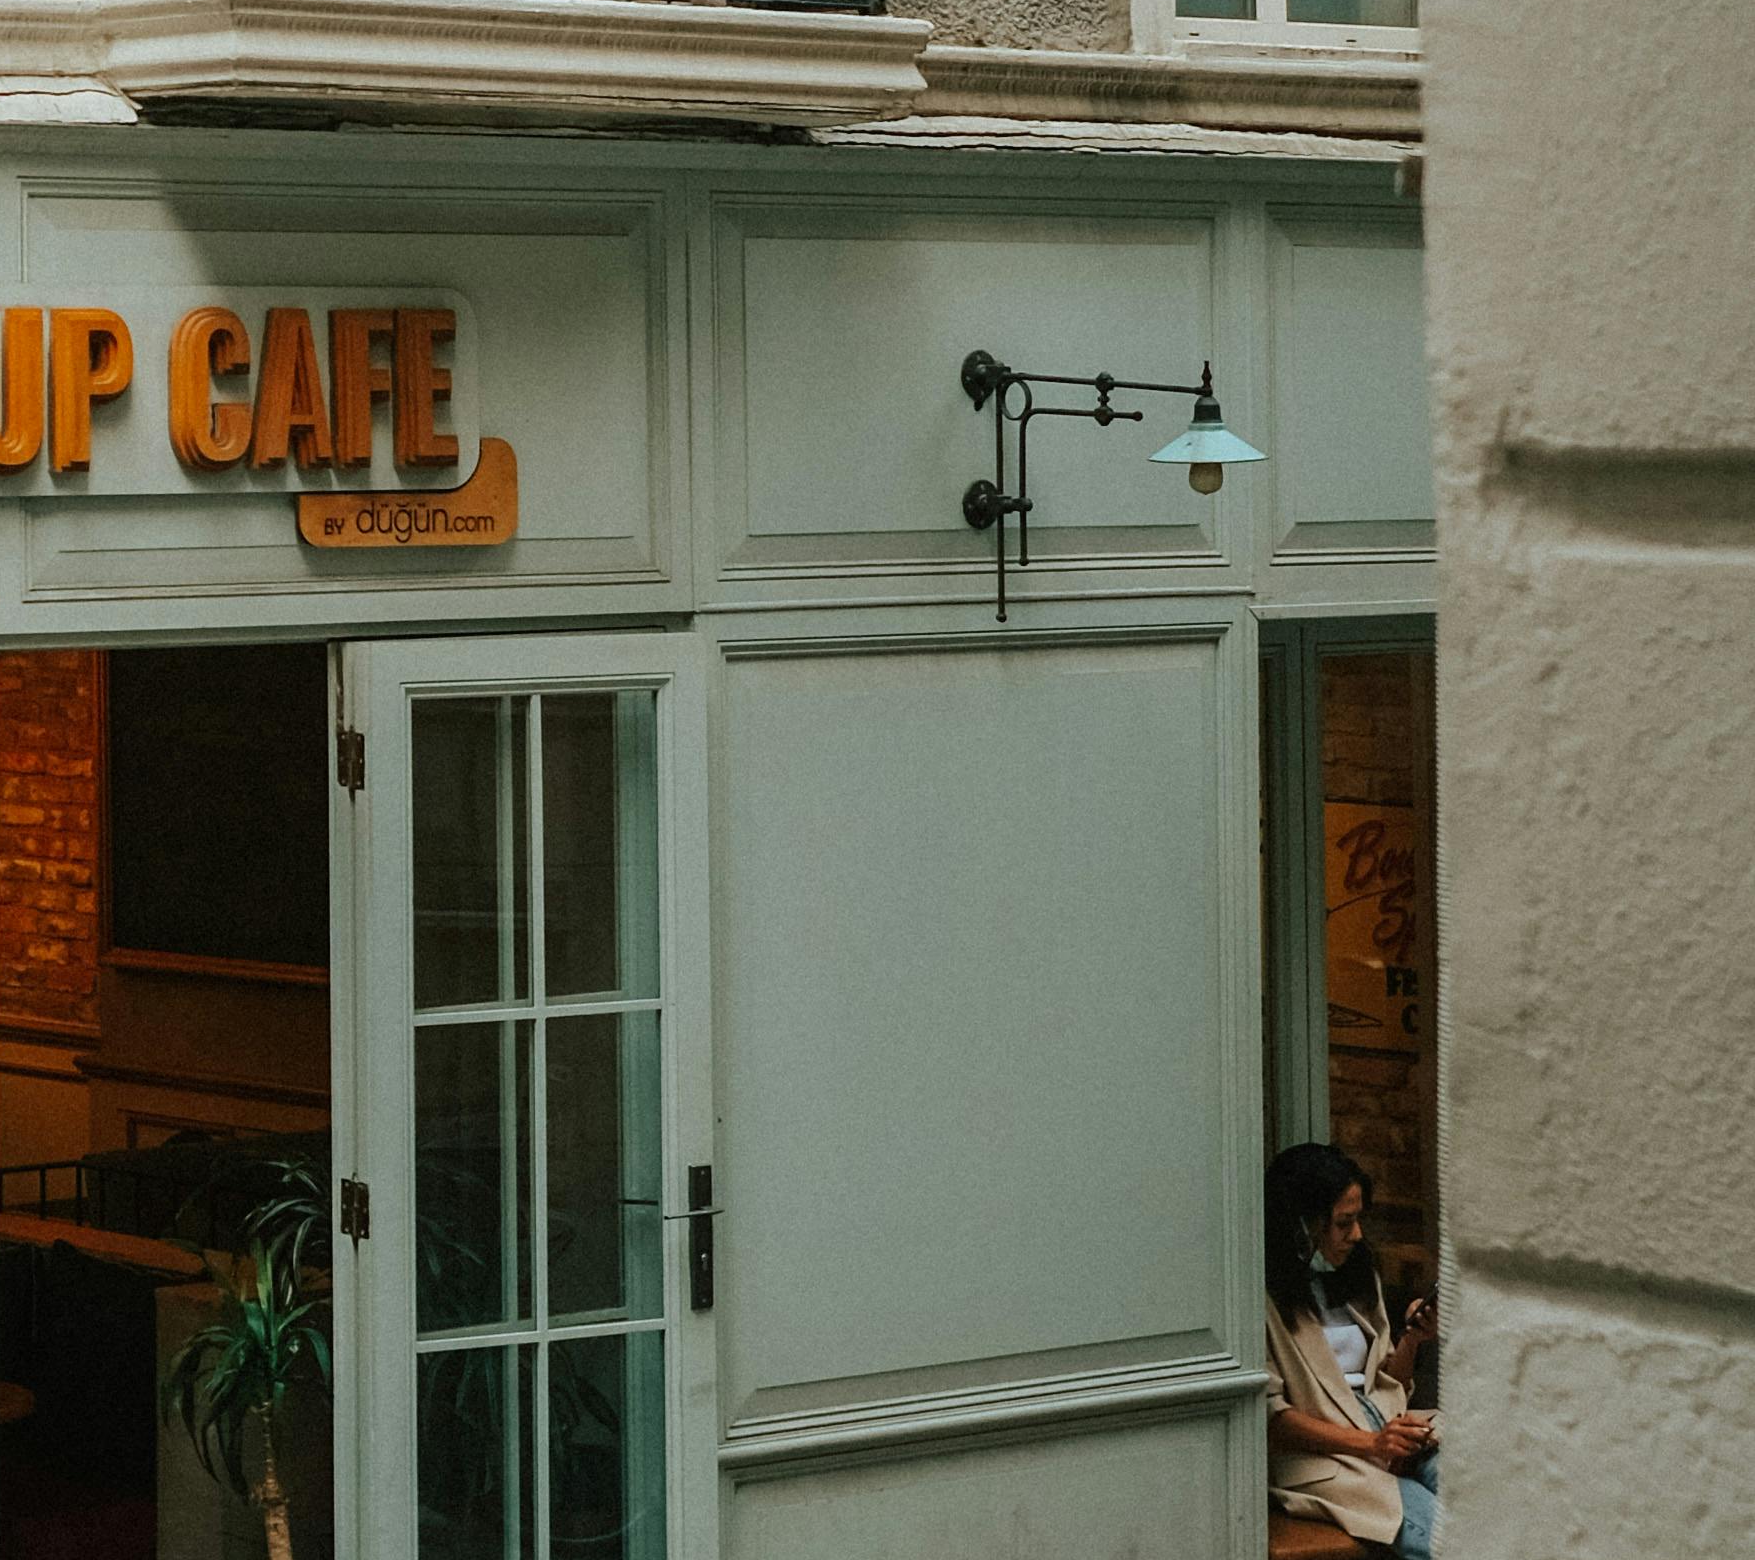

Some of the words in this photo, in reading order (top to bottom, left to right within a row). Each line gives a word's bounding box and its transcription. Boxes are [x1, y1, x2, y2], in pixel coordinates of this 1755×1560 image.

[168, 306, 459, 470] CAFE
[324, 517, 345, 536] BY
[355, 501, 495, 544] düğün.com
